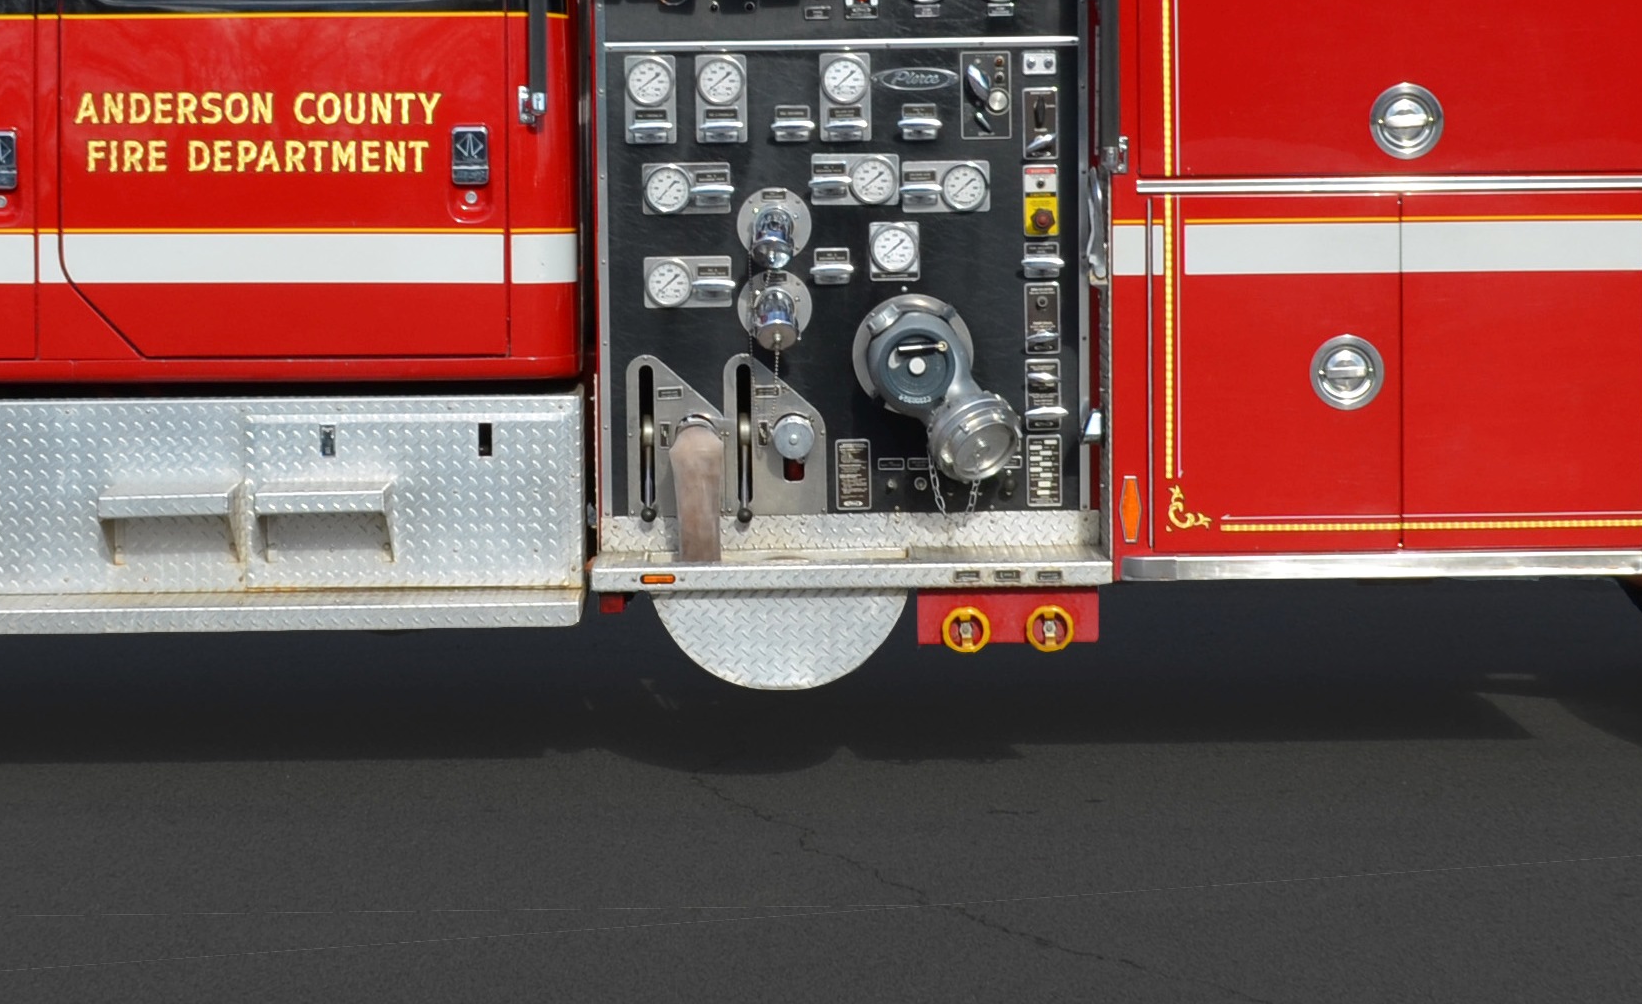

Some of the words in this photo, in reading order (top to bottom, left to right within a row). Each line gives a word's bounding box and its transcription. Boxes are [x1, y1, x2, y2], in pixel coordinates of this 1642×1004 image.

[74, 91, 274, 126] ANDERSON
[293, 90, 442, 125] COUNTY
[86, 139, 168, 174] FIRE
[188, 139, 430, 174] DEPARTMENT
